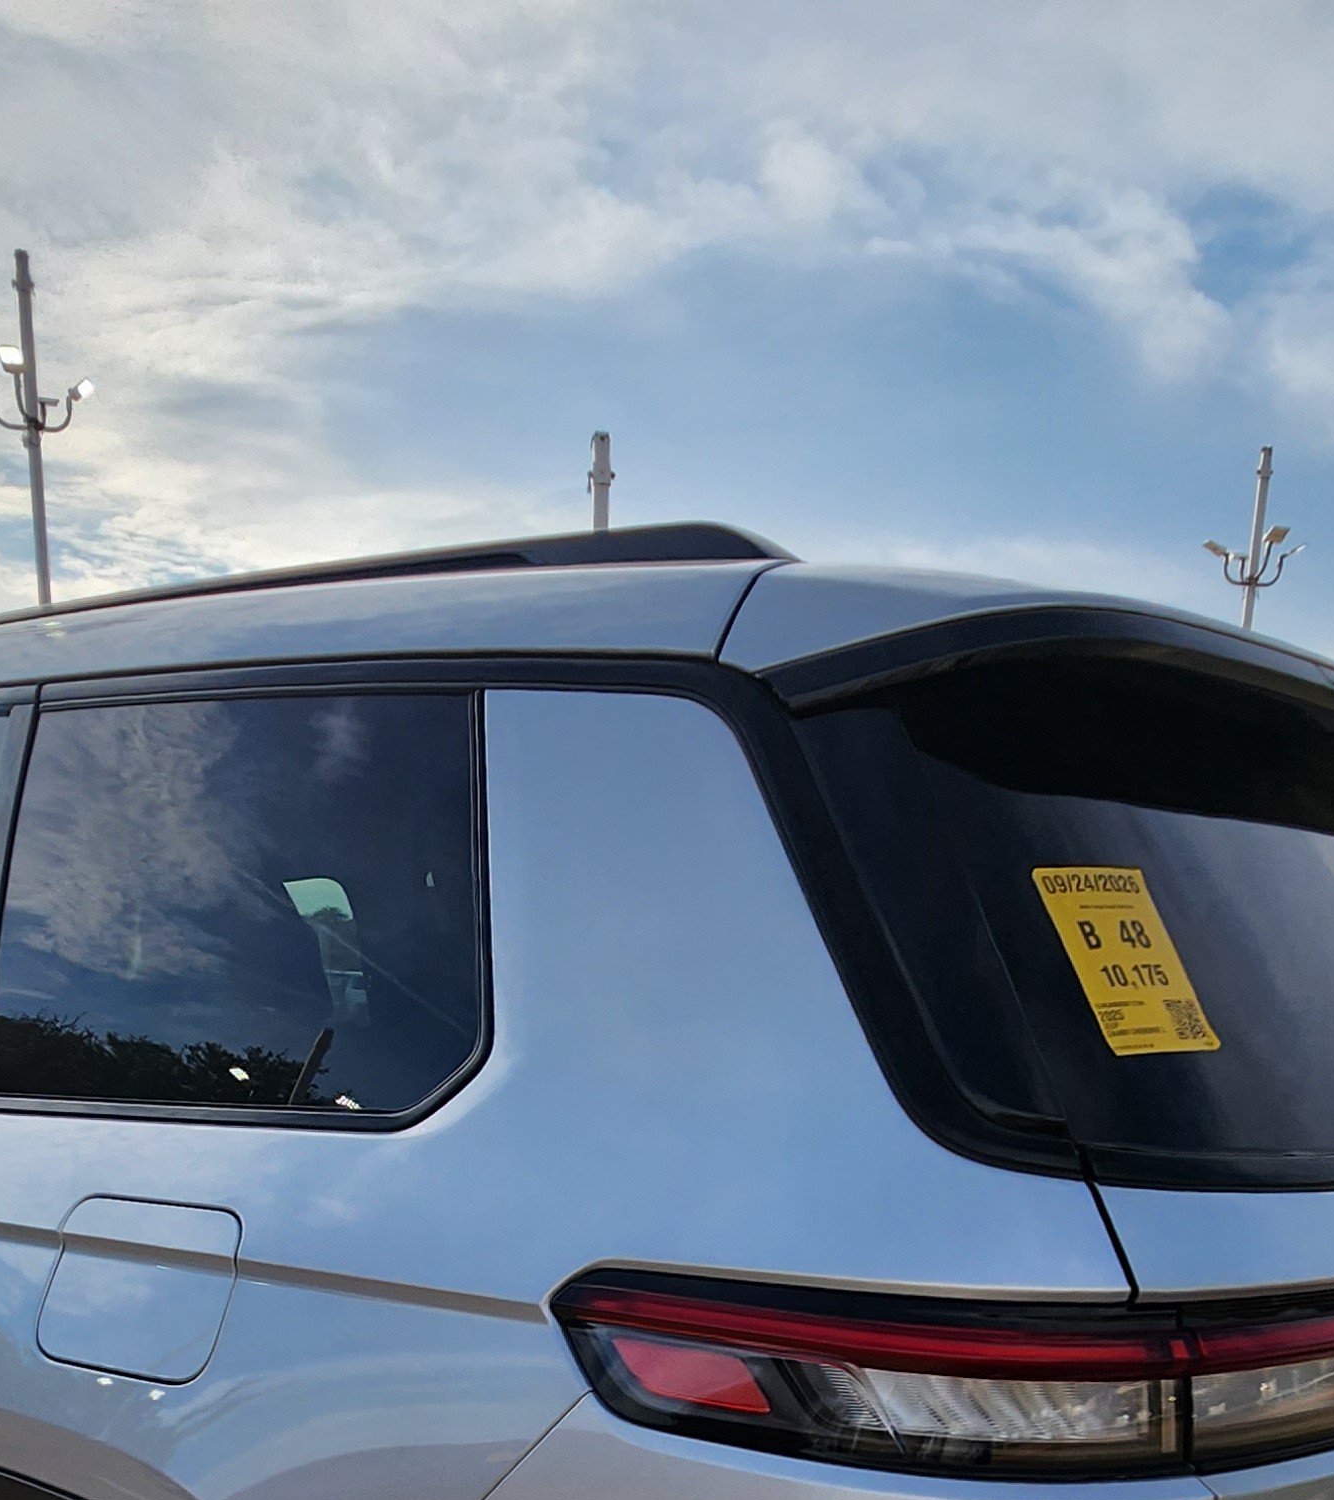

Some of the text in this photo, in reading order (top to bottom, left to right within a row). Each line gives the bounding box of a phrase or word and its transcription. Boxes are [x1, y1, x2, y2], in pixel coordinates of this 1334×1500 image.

[1077, 920, 1152, 950] B 48
[1100, 964, 1169, 989] 10,175
